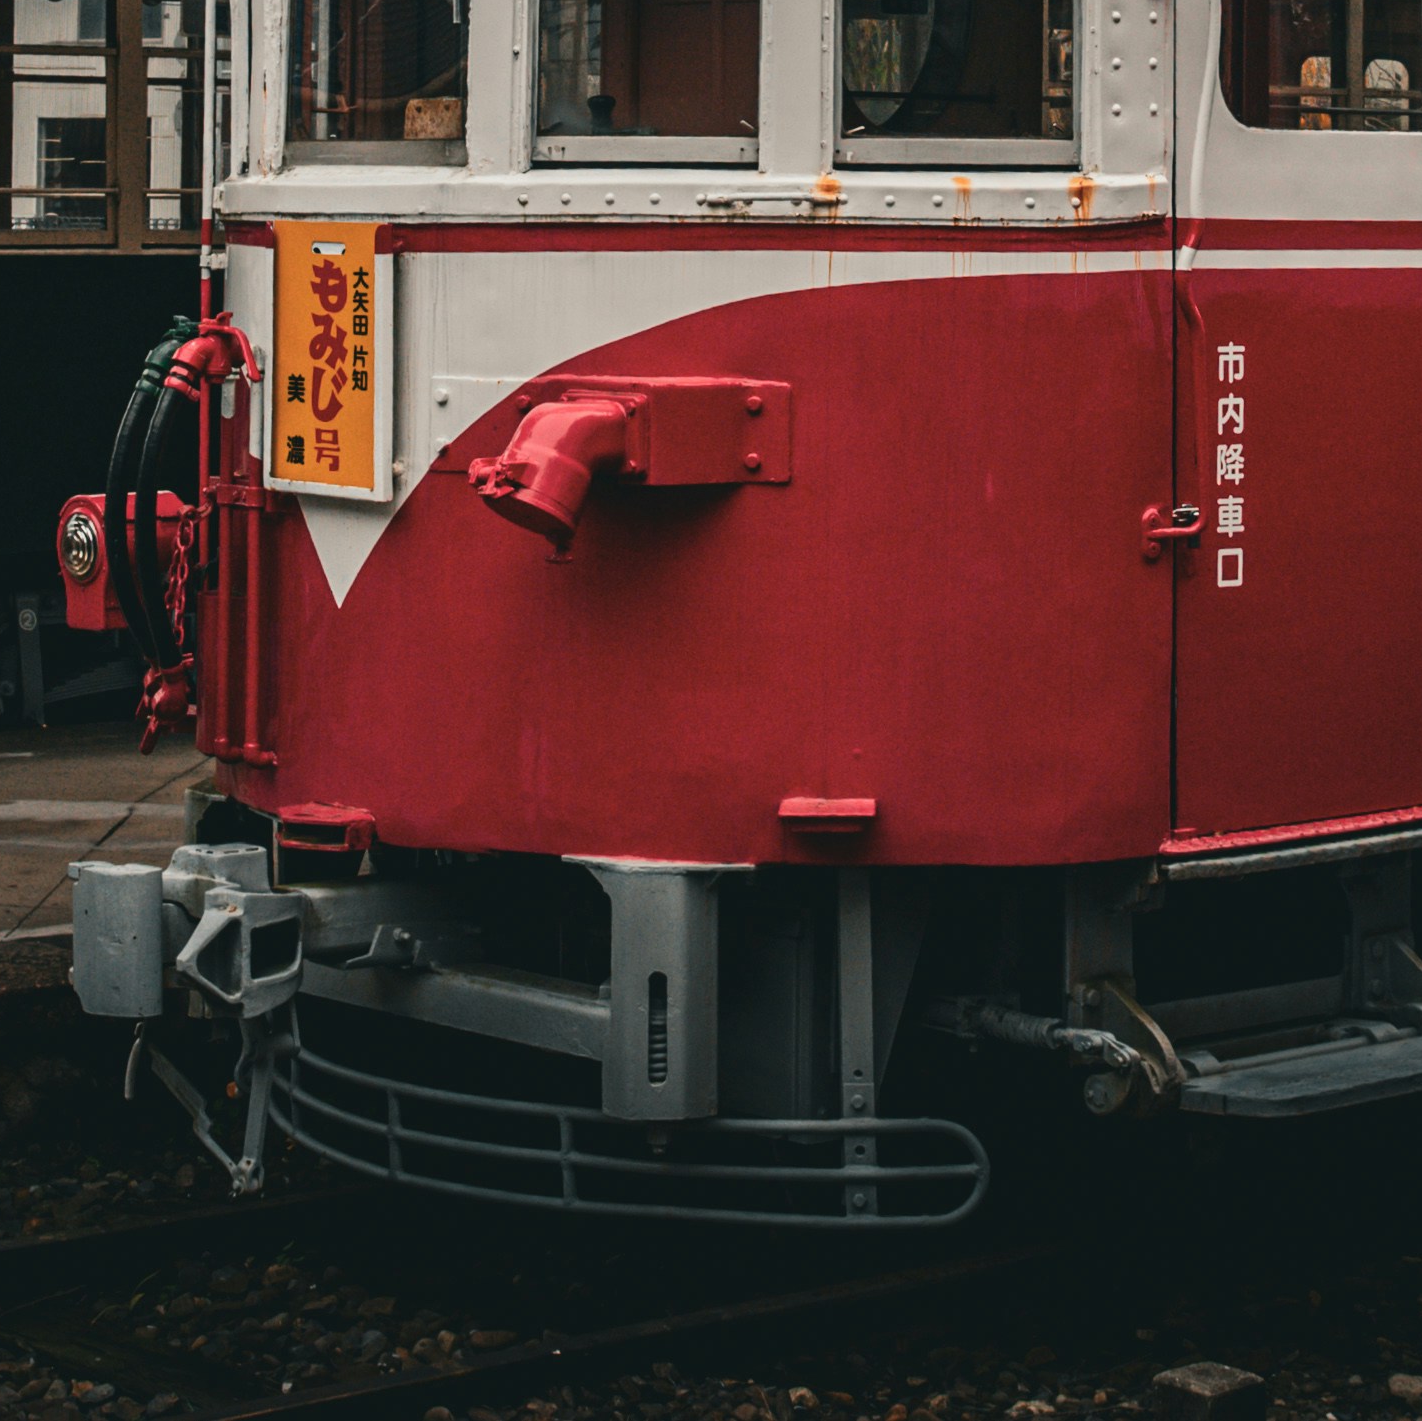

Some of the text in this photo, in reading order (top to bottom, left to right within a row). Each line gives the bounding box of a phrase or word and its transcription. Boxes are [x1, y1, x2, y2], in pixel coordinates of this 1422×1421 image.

[310, 259, 348, 472] もみじ号
[352, 267, 370, 392] 大矢田 片知
[286, 374, 305, 465] 美濃
[1215, 341, 1246, 589] 市内降車口
